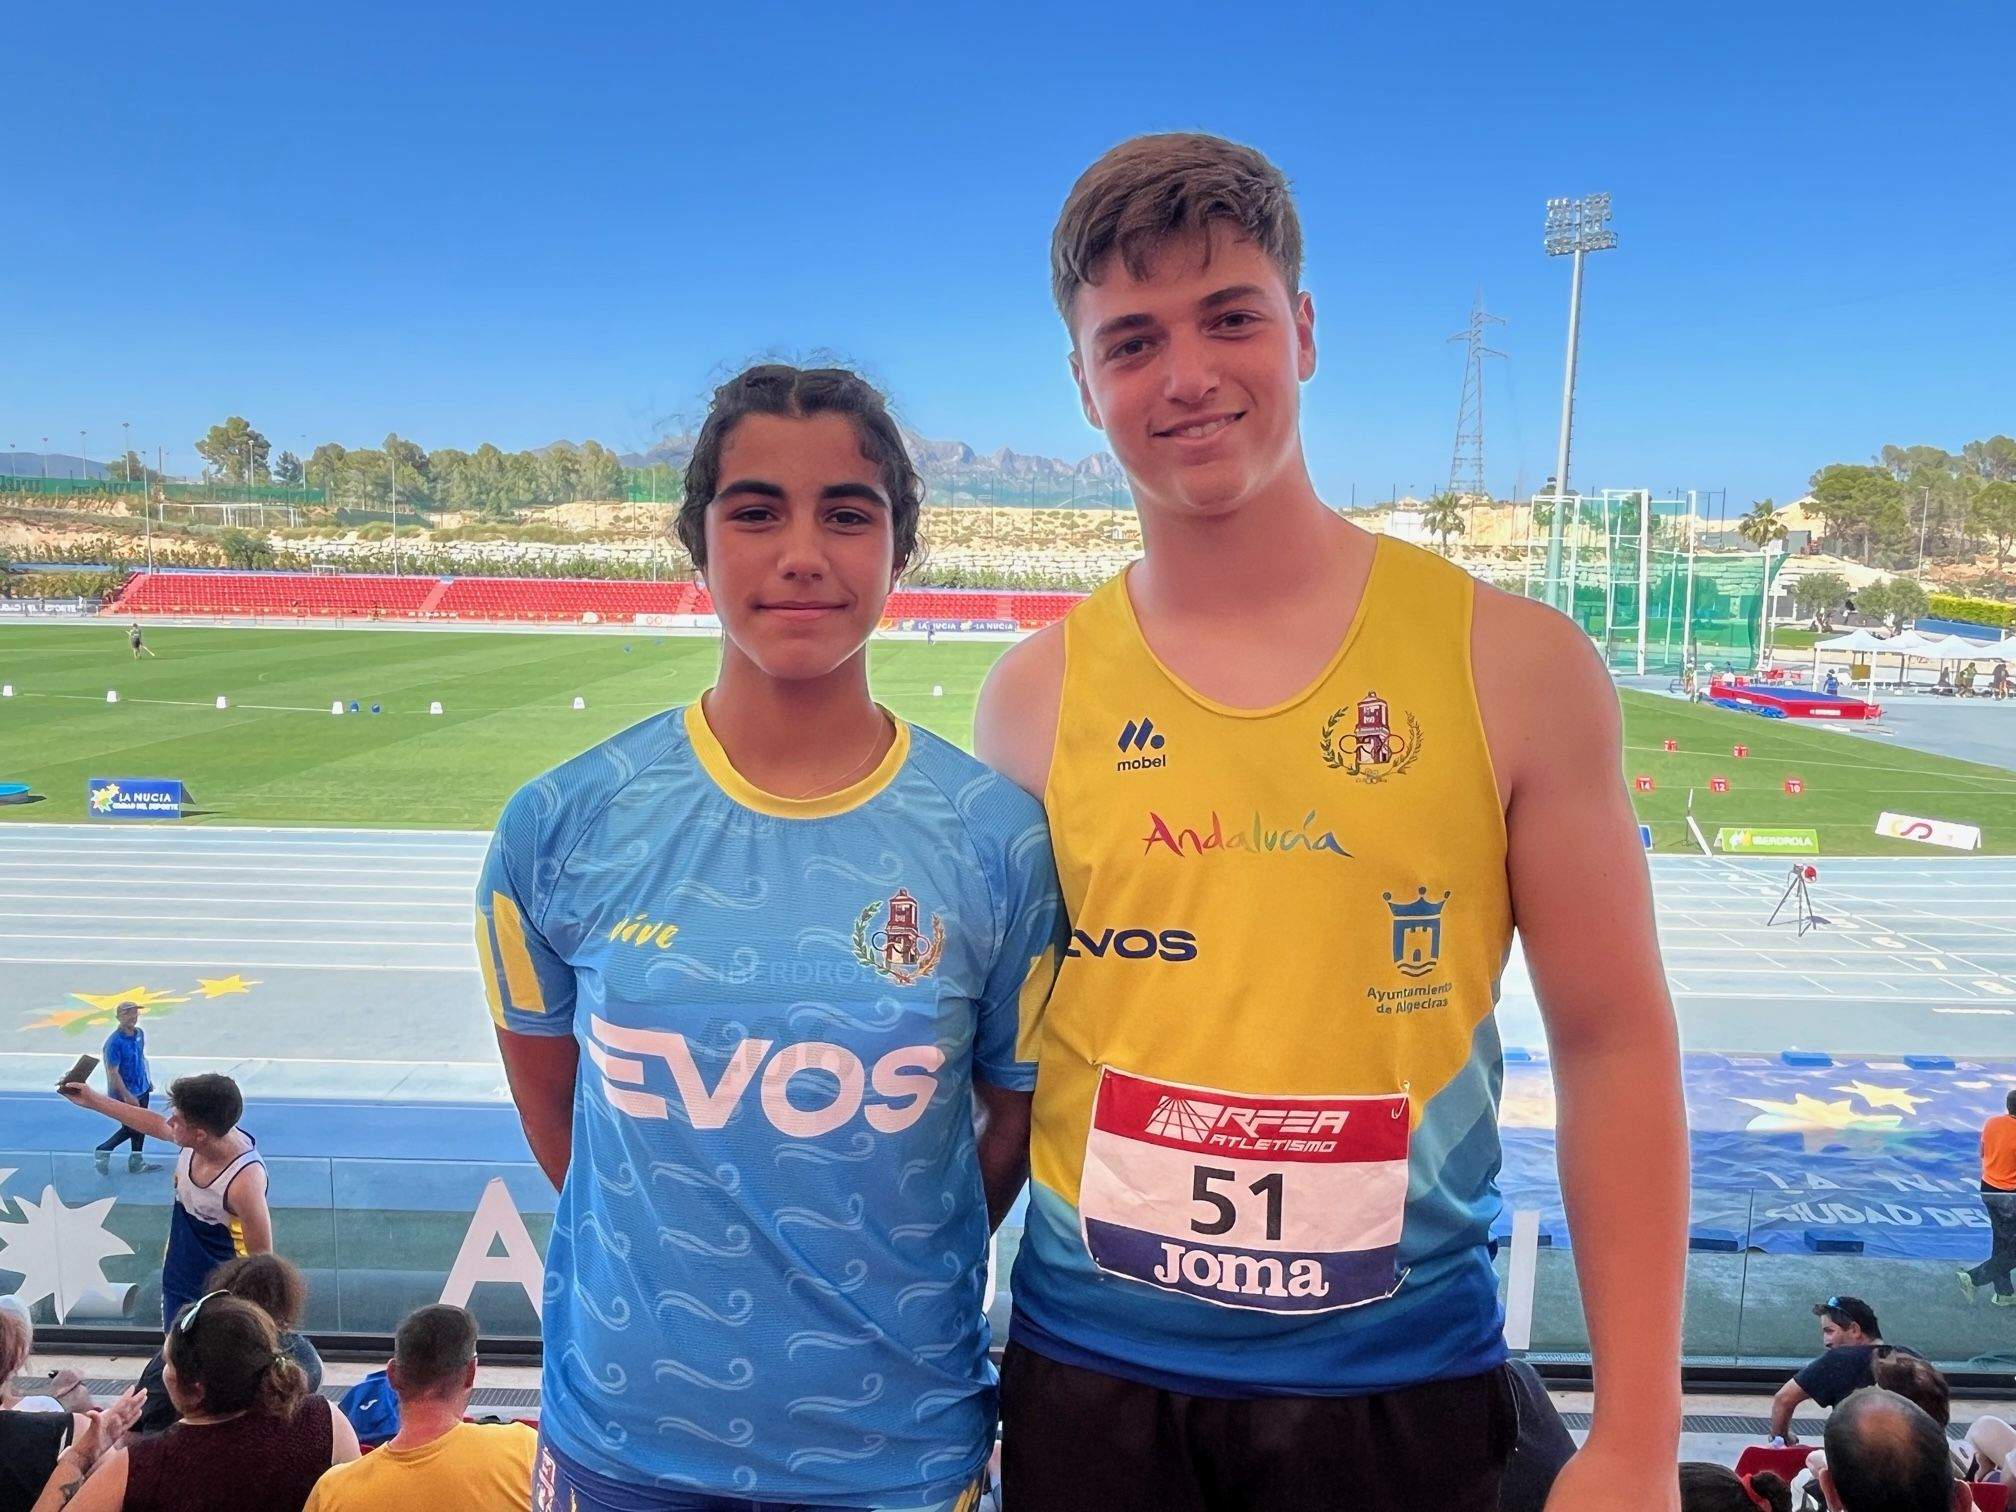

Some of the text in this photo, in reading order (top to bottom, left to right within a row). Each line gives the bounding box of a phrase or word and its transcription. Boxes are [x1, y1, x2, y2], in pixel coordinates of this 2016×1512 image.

[1117, 754, 1166, 772] mobel
[119, 793, 172, 802] LA NUCIA
[1142, 809, 1355, 858] Andalucía
[1752, 835, 1814, 847] IBERDROLA
[1367, 982, 1453, 1002] Ayuntamiento
[1376, 997, 1449, 1014] de Algeciras
[588, 1013, 947, 1138] EVOS
[1218, 1105, 1350, 1138] RFEA
[1209, 1133, 1338, 1154] ATLETISMO
[1190, 1165, 1285, 1242] 51
